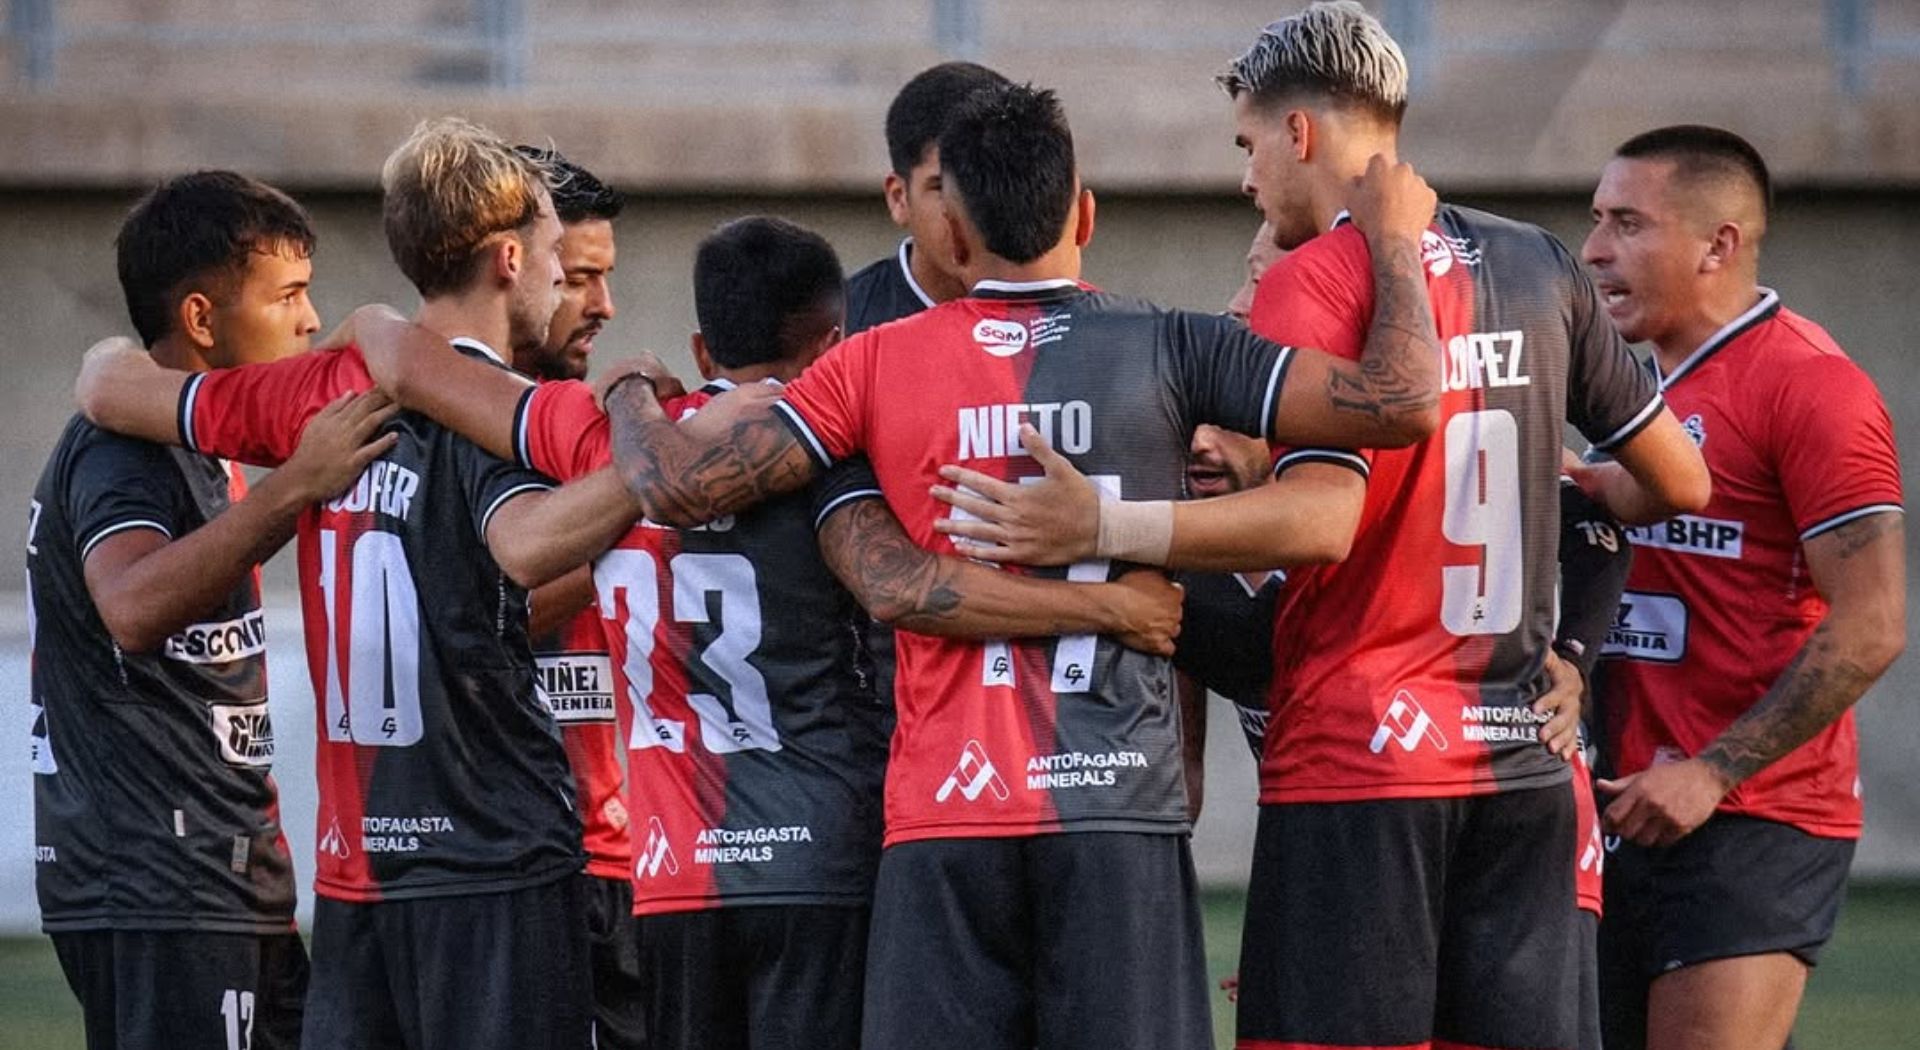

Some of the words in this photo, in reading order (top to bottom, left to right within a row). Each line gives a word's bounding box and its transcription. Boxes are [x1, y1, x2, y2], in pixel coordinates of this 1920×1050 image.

[979, 325, 1023, 341] SQM
[958, 400, 1092, 460] NIETO
[1440, 409, 1523, 636] 9
[1666, 519, 1739, 550] BHP
[1575, 520, 1619, 553] 19
[320, 529, 424, 747] 10
[593, 548, 783, 754] 23
[1462, 725, 1539, 742] MINERALS
[1026, 751, 1148, 771] ANTOFAGASTA
[1027, 770, 1116, 790] MINERALS
[696, 826, 812, 845] ANTOFAGASTA
[694, 846, 773, 864] MINERALS
